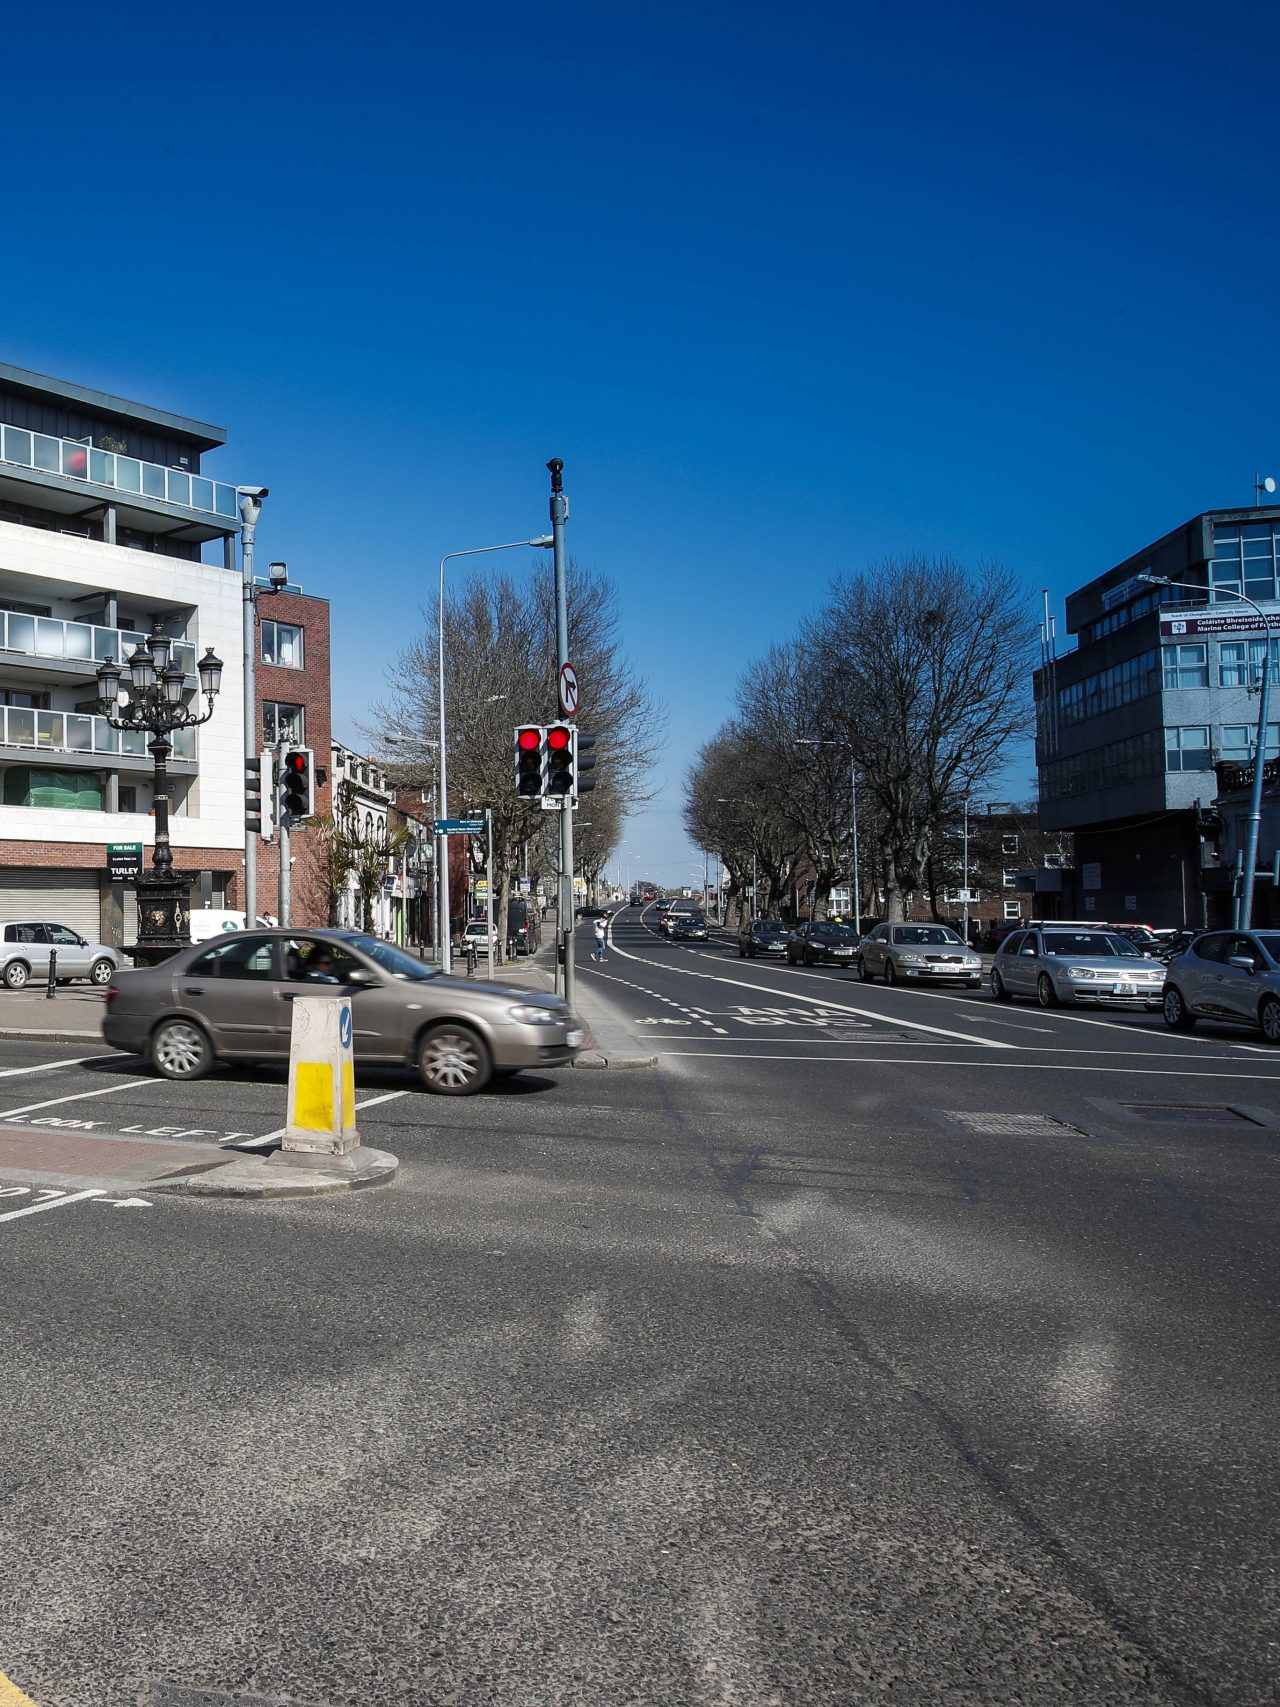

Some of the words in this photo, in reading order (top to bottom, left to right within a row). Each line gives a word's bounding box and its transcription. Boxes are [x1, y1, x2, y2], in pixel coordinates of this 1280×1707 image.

[111, 867, 139, 875] TURLEY
[731, 1016, 873, 1027] BUS
[4, 1114, 112, 1130] LOOK
[119, 1124, 255, 1143] LEFT
